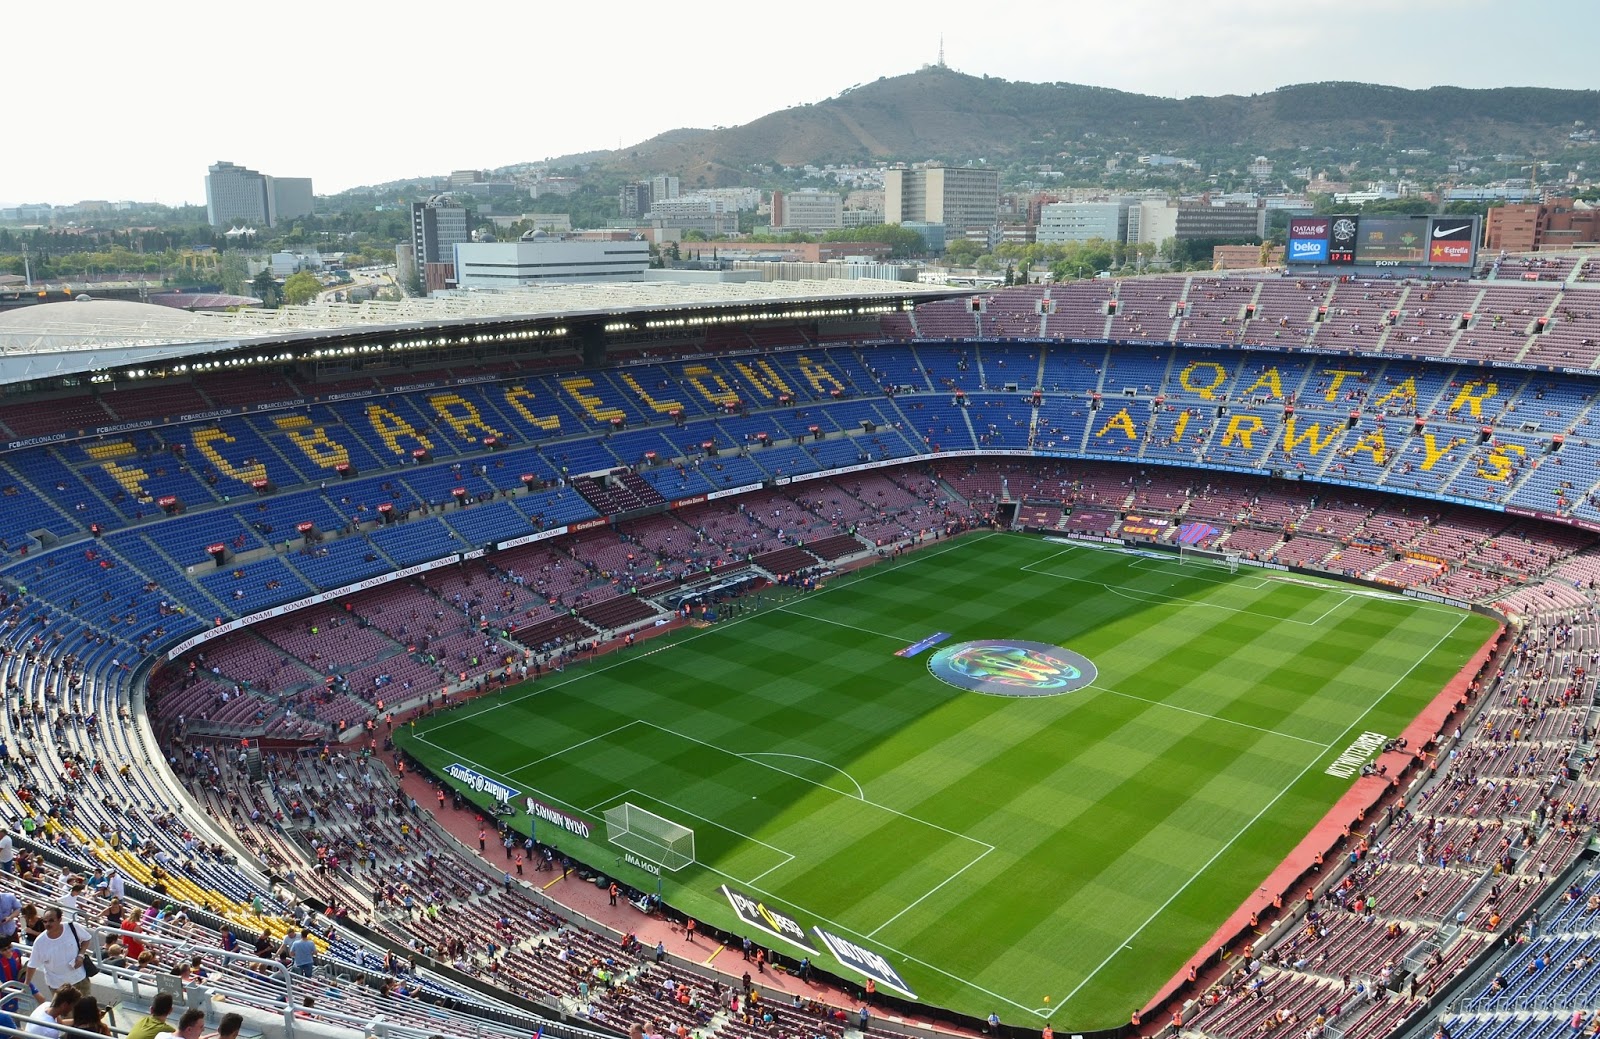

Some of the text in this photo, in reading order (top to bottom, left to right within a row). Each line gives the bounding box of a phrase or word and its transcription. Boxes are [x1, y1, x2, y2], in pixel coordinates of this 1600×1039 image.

[1292, 225, 1316, 233] QATAR
[1293, 241, 1321, 252] beko
[1361, 352, 1404, 360] FCBARCELONA.COM
[1424, 356, 1468, 365] FCBARCELONA.COM
[1491, 361, 1538, 371] FCBARCELONA.COM
[457, 375, 496, 384] FCBARCELONA.COM
[393, 382, 436, 392] FCBARCELONA.COM
[1179, 360, 1498, 417] QATAR
[328, 390, 372, 400] FCBARCELONA.COM
[257, 399, 305, 410] FCBARCELONA.COM
[180, 408, 232, 421] FCBARCELONA.COM
[80, 354, 845, 502] FC BARCELONA
[96, 420, 153, 434] FCBARCELONA.COM
[9, 433, 66, 449] FCBARCELONA.COM
[1096, 407, 1527, 481] AIRWAYS
[537, 528, 560, 539] KONAMI
[506, 536, 530, 548] KONAMI
[430, 556, 456, 568] KONAMI
[395, 565, 422, 578] KONAMI
[360, 575, 388, 589] KONAMI
[321, 586, 351, 600] KONAMI
[283, 598, 313, 612] KONAMI
[241, 610, 273, 625] KONAMI
[203, 623, 233, 639] KONAMI
[172, 639, 195, 656] KONAMI
[449, 766, 510, 804] Allianz Seguros
[535, 803, 589, 839] QATAR AIRWAYS
[823, 931, 909, 991] beko.com
